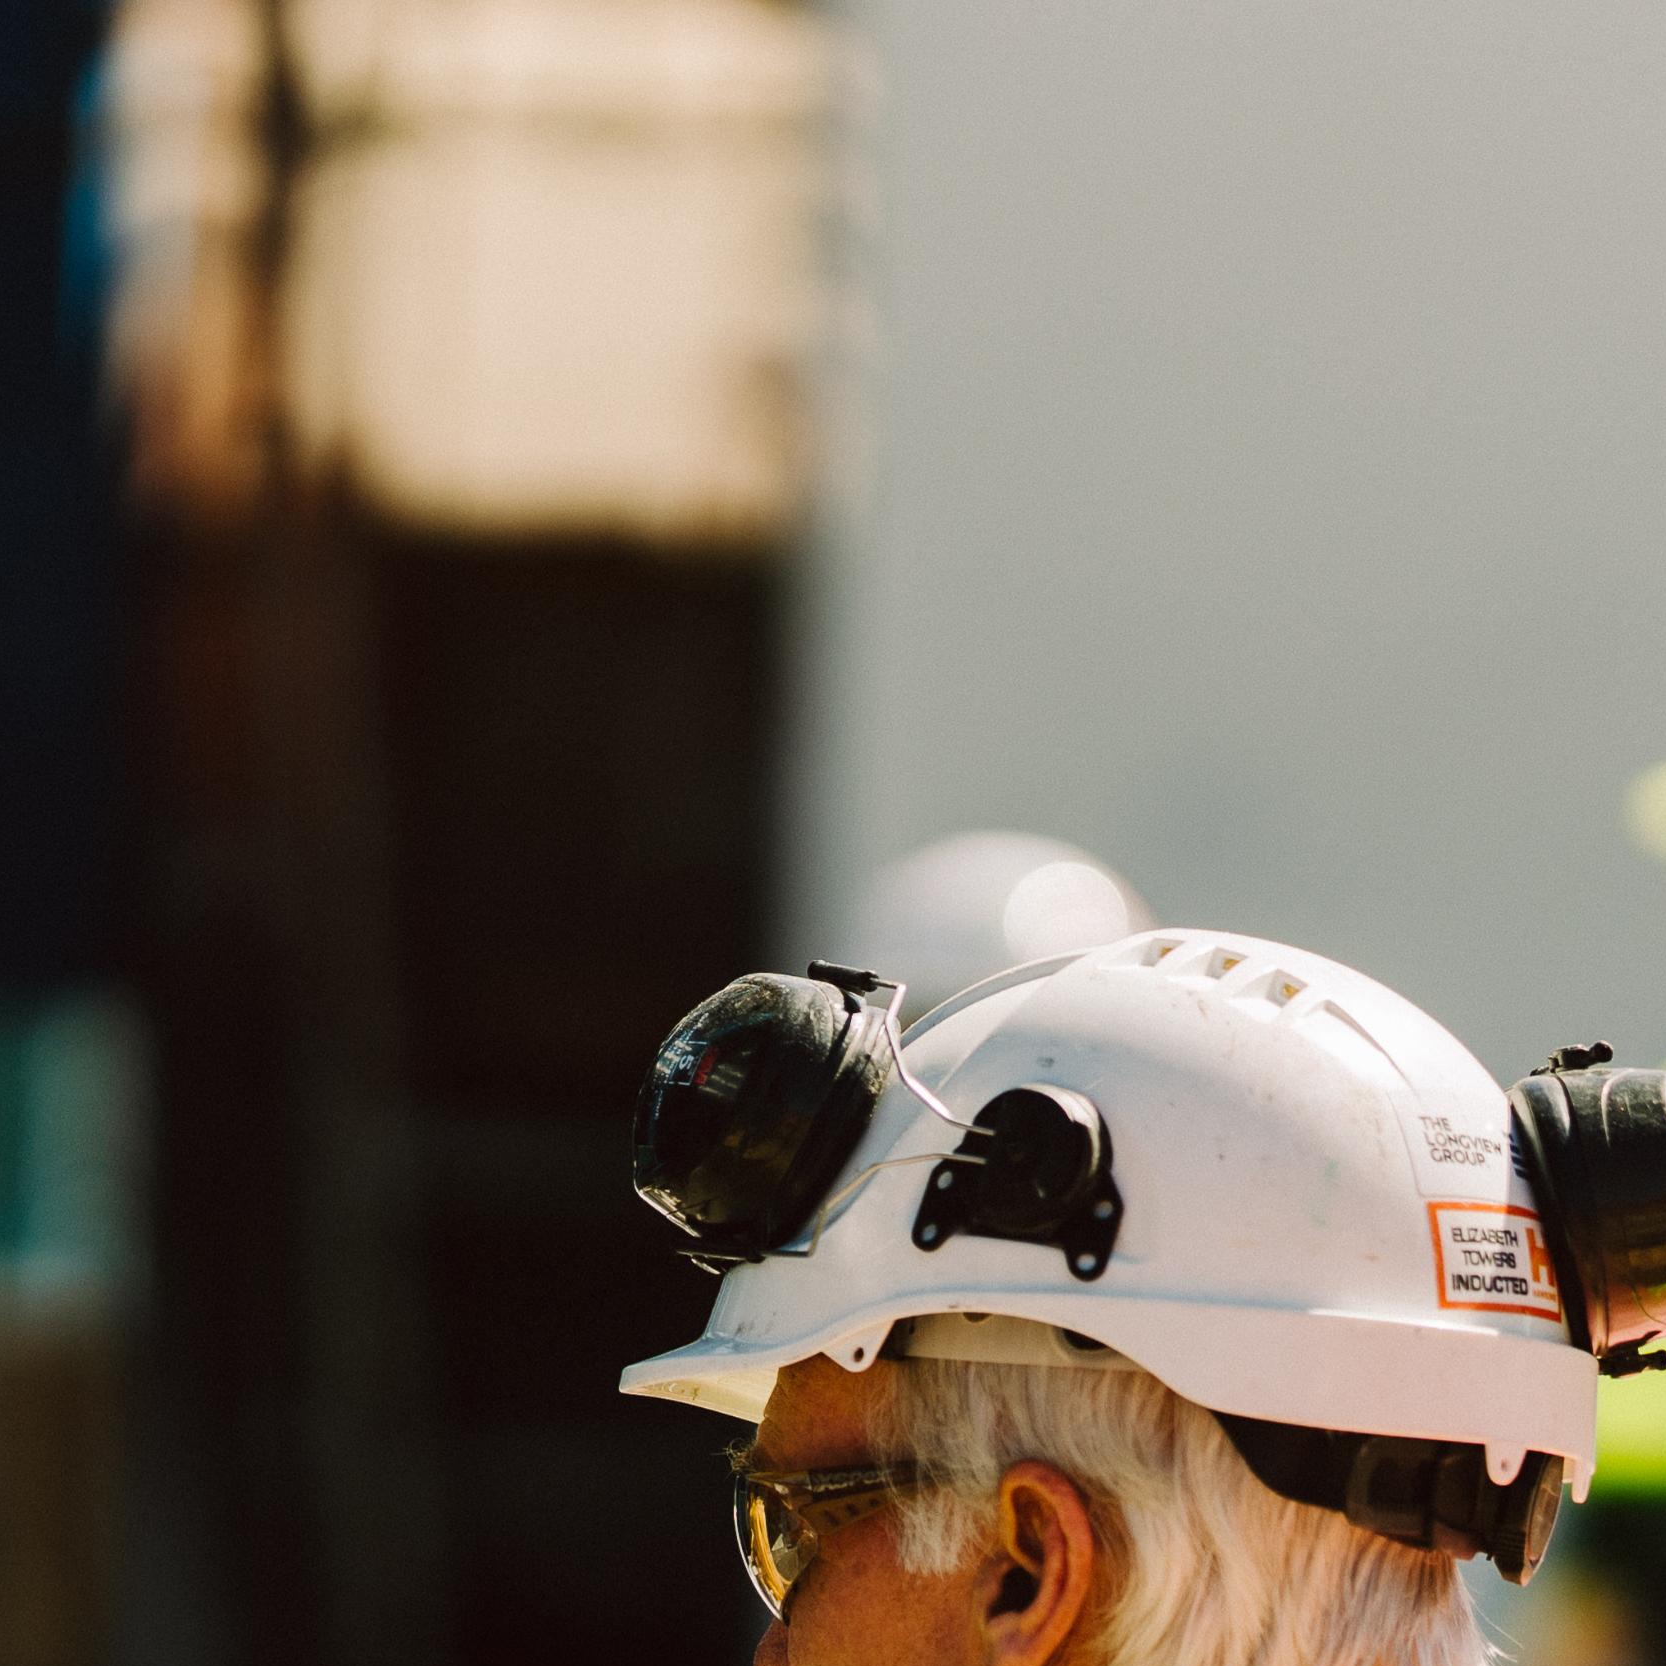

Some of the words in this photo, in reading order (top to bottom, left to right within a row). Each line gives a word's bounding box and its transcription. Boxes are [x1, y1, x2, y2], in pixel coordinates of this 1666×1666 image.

[1420, 1116, 1452, 1131] THE
[1424, 1132, 1501, 1155] LONGVIEW
[1431, 1147, 1485, 1165] GROUP
[1452, 1227, 1518, 1246] ELIZABETH
[1462, 1250, 1516, 1269] TOWERS
[1452, 1274, 1528, 1295] INDUCTED
